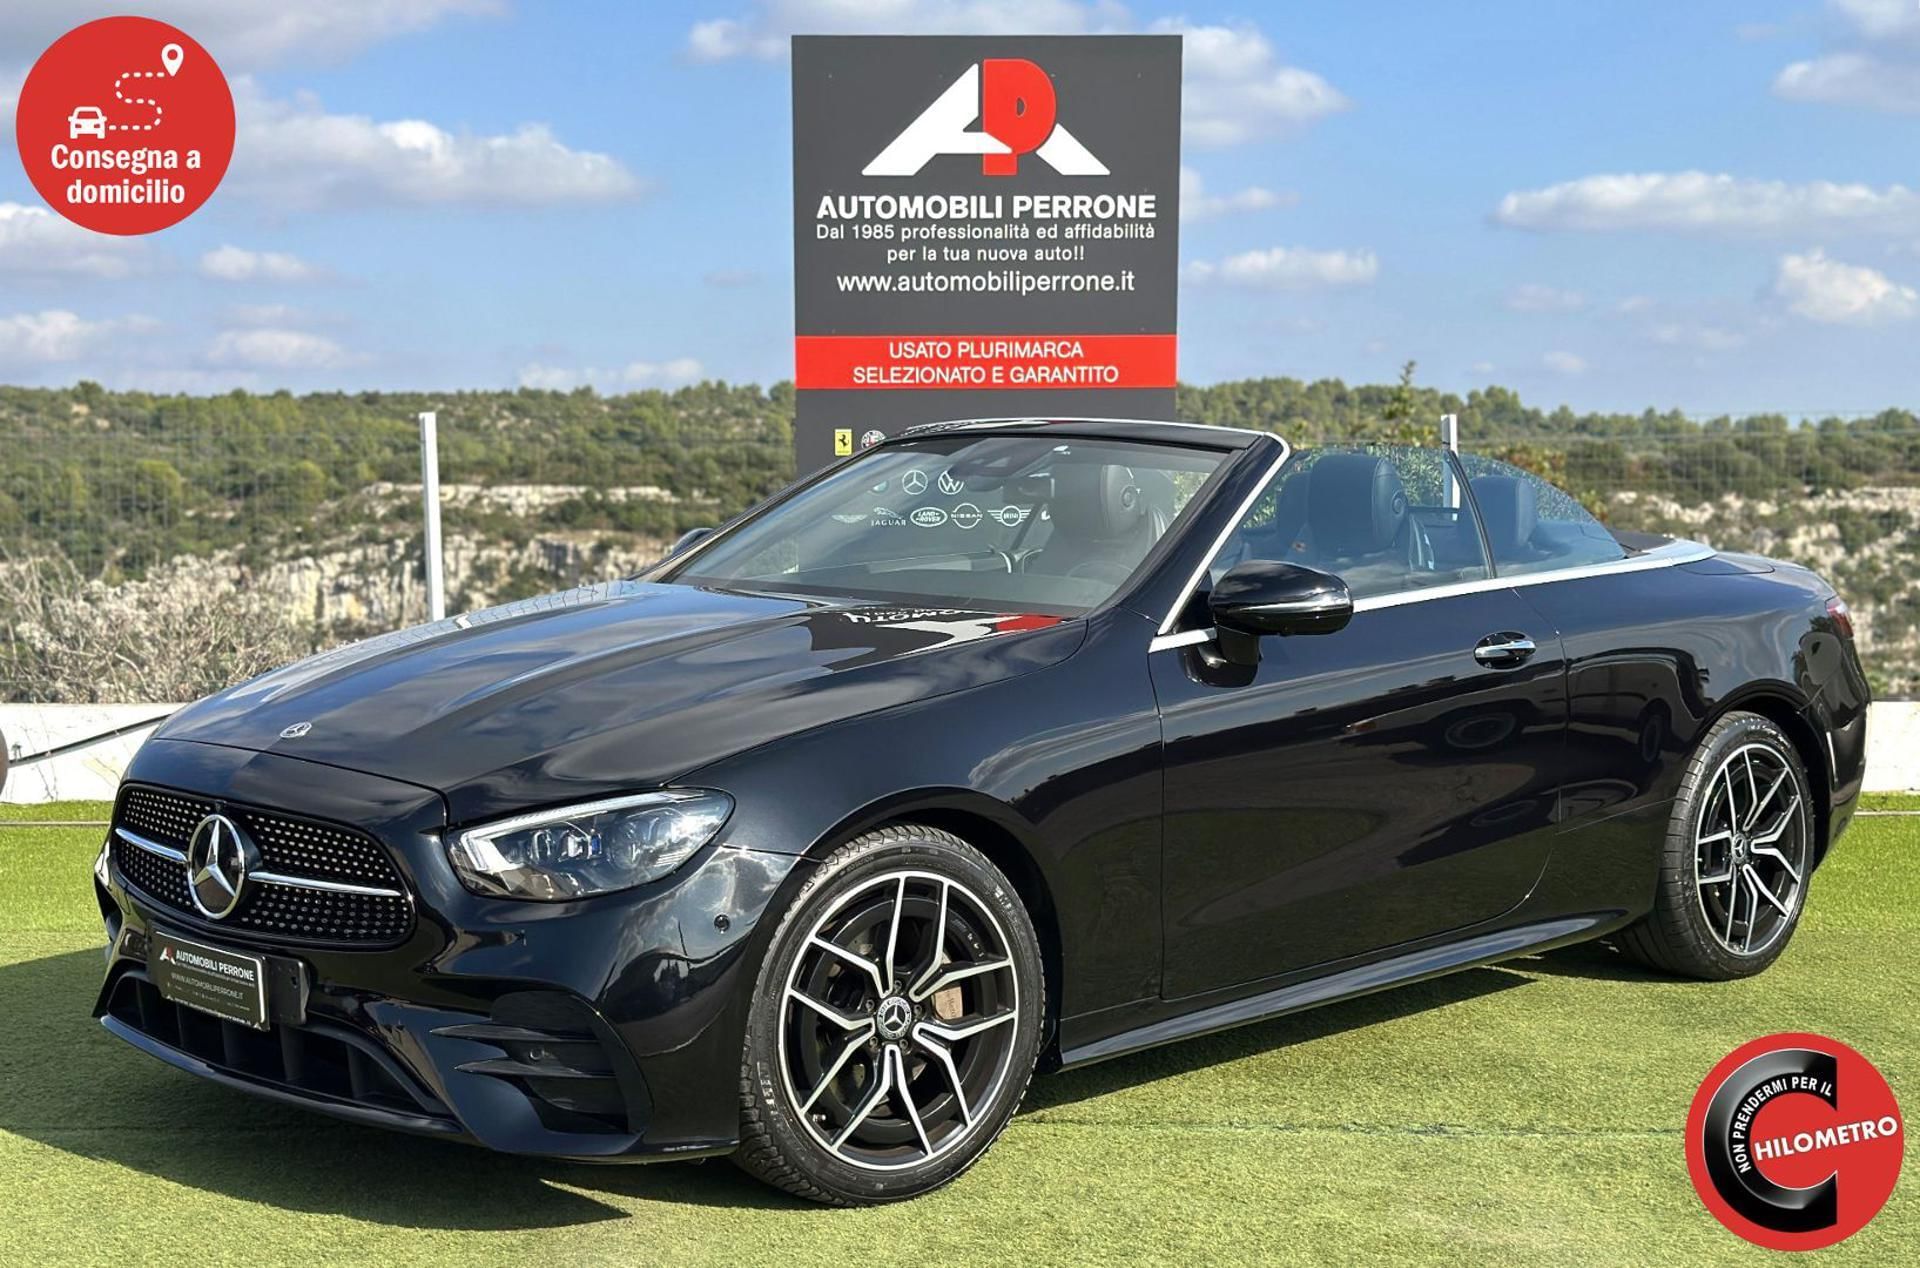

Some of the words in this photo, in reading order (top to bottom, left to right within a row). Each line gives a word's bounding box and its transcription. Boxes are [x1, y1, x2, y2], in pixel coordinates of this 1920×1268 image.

[816, 194, 1003, 220] AUTOMOBILI
[1012, 194, 1157, 219] PERRONE
[816, 223, 845, 240] Dal
[851, 223, 895, 240] 1985
[901, 223, 1030, 243] professionalità
[1036, 223, 1058, 240] ed
[1064, 222, 1155, 240] affidabilità
[887, 248, 916, 264] per
[922, 245, 937, 262] la
[942, 246, 970, 262] tua
[976, 248, 1028, 262] nuova
[1034, 245, 1085, 261] auto!!
[836, 269, 1136, 297] www.automobiliperrone.it
[889, 341, 952, 359] USATO
[957, 341, 1084, 359] PLURIMARCA
[853, 366, 986, 384] SELEZIONATO
[992, 366, 1004, 383] E
[1009, 365, 1119, 383] GARANTITO
[870, 519, 907, 527] JAGUAR
[175, 949, 218, 972] AUTOMOBILI
[218, 961, 255, 982] PERRONE
